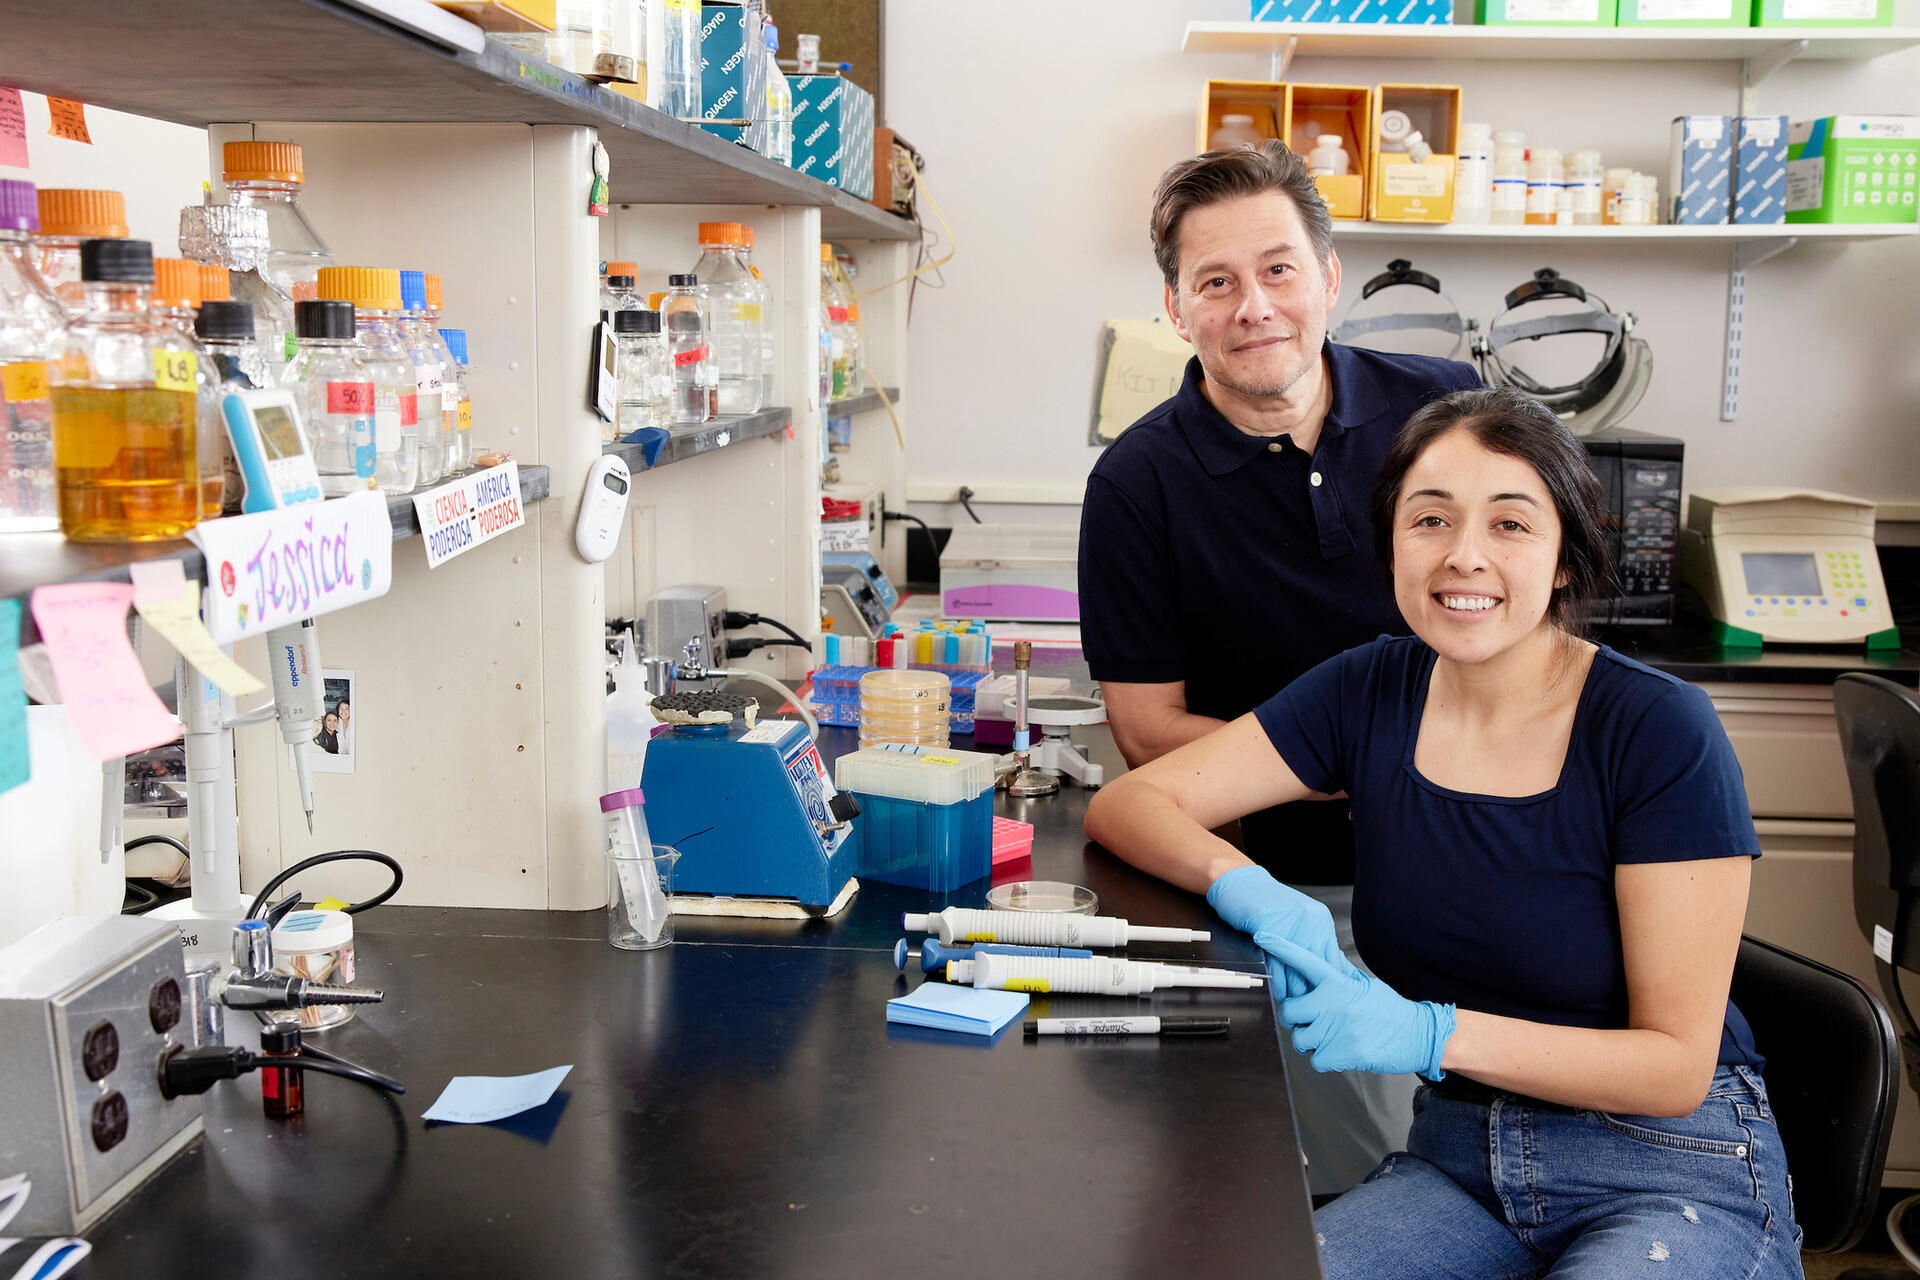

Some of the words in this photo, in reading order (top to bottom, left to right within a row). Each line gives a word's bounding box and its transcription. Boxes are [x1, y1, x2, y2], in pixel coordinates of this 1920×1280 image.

[704, 86, 738, 120] QIAGEN
[804, 120, 831, 147] QIAGEN
[167, 358, 189, 382] LB
[435, 489, 469, 526] CIENCIA
[475, 472, 512, 508] AMÉRICA
[478, 498, 520, 537] PODEROSA
[429, 518, 473, 561] PODEROSA
[247, 516, 354, 622] Jessica
[285, 645, 300, 687] eppendorf
[181, 934, 199, 948] 318
[1091, 1022, 1133, 1034] Sharpie
